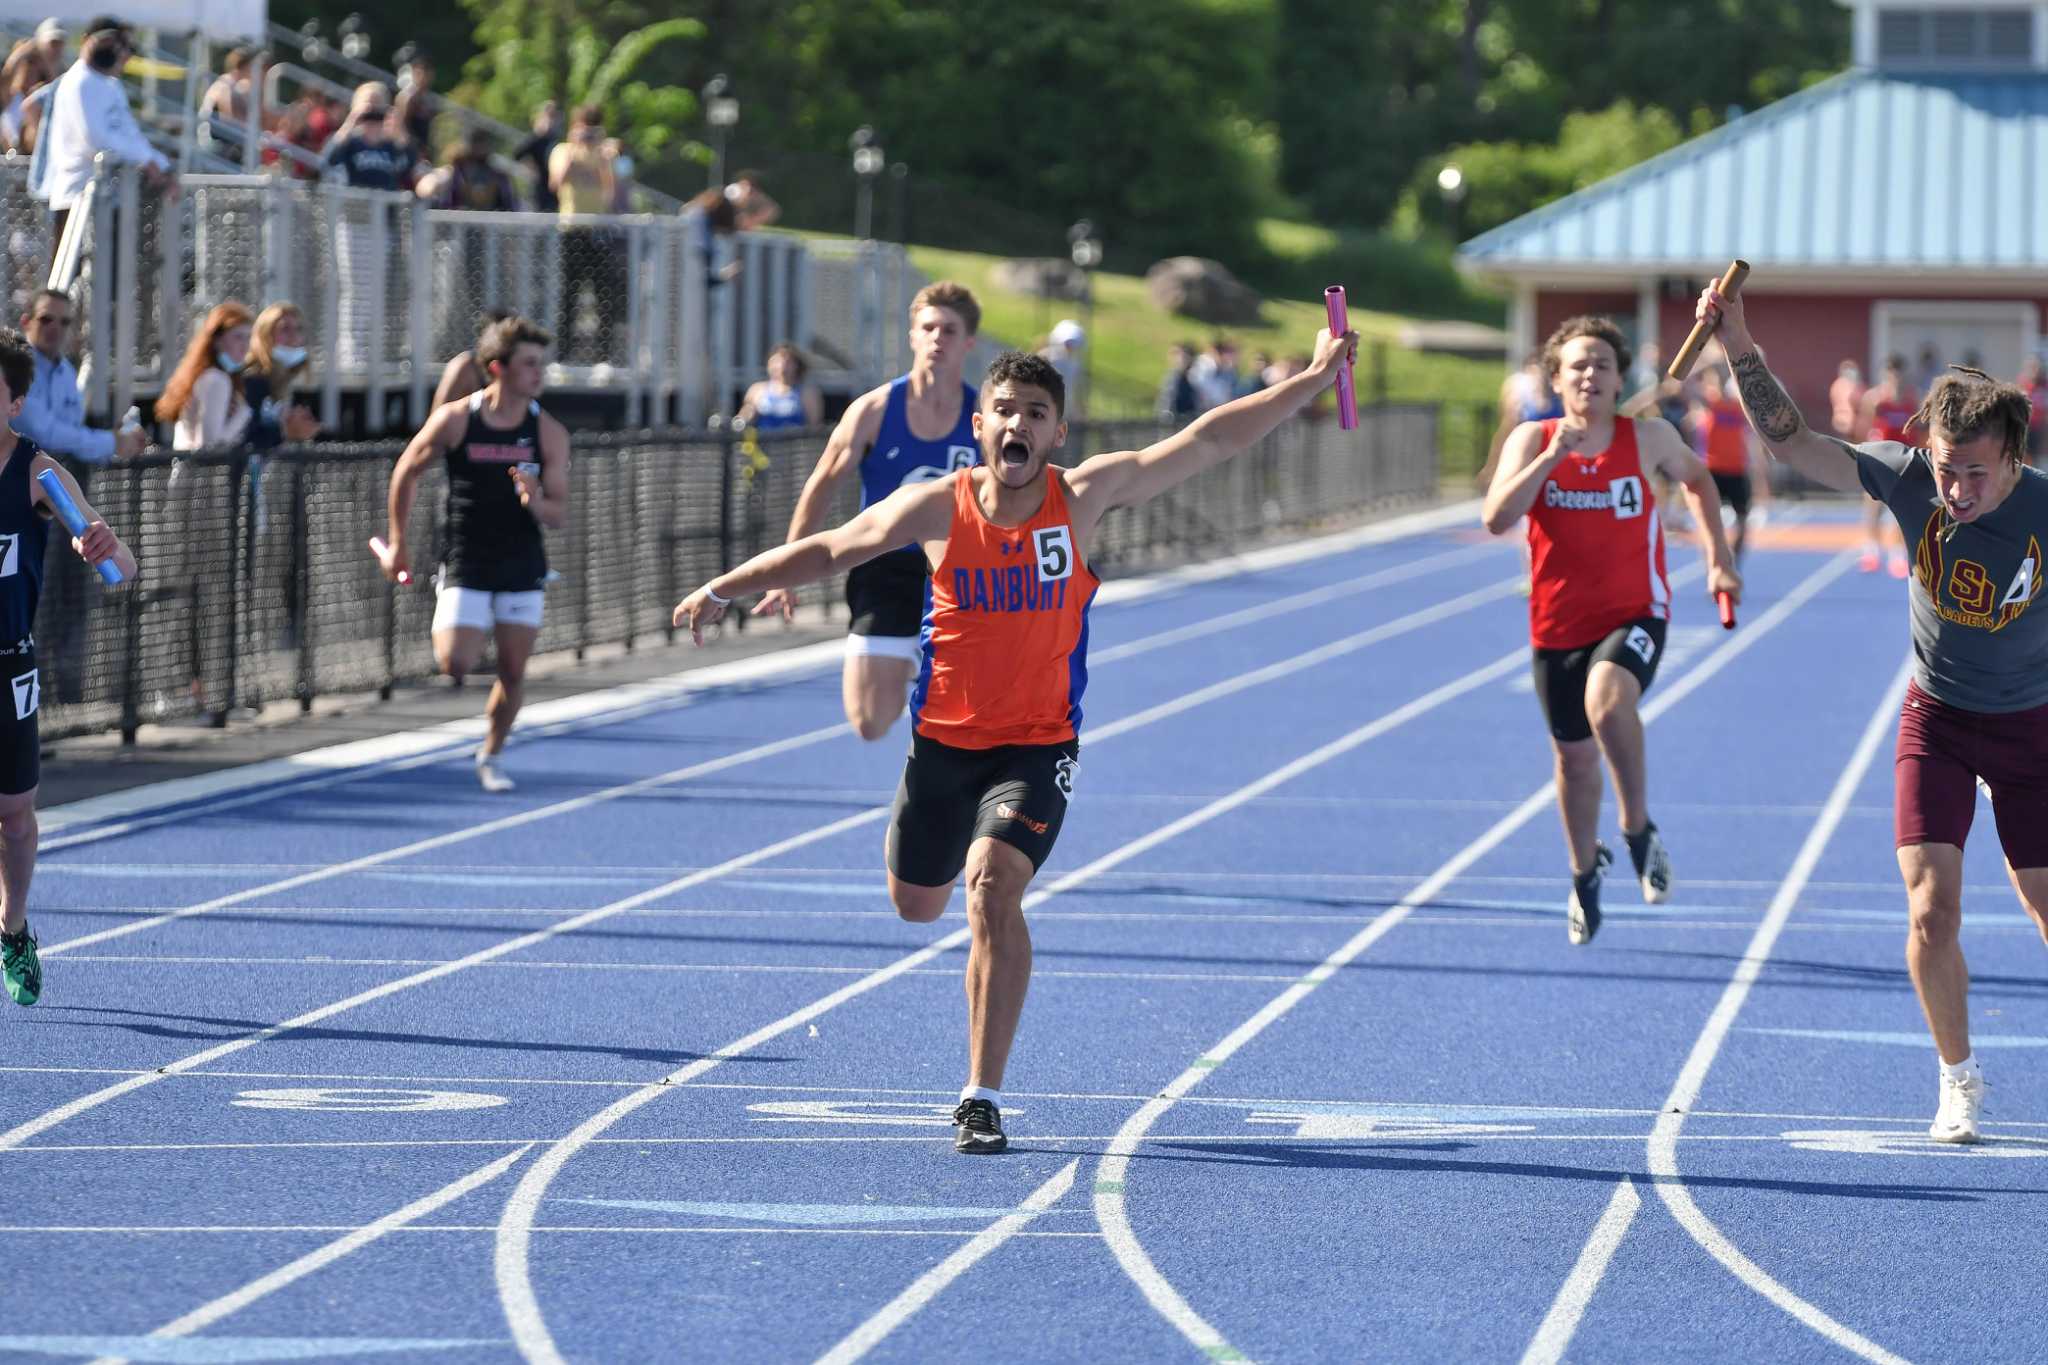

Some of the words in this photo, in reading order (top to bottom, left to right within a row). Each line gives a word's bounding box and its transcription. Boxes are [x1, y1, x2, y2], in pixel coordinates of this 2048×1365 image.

[1619, 480, 1638, 513] 4
[1039, 530, 1067, 577] 5
[953, 562, 1069, 614] DANBURY
[1634, 633, 1651, 655] 4
[15, 673, 35, 715] 7
